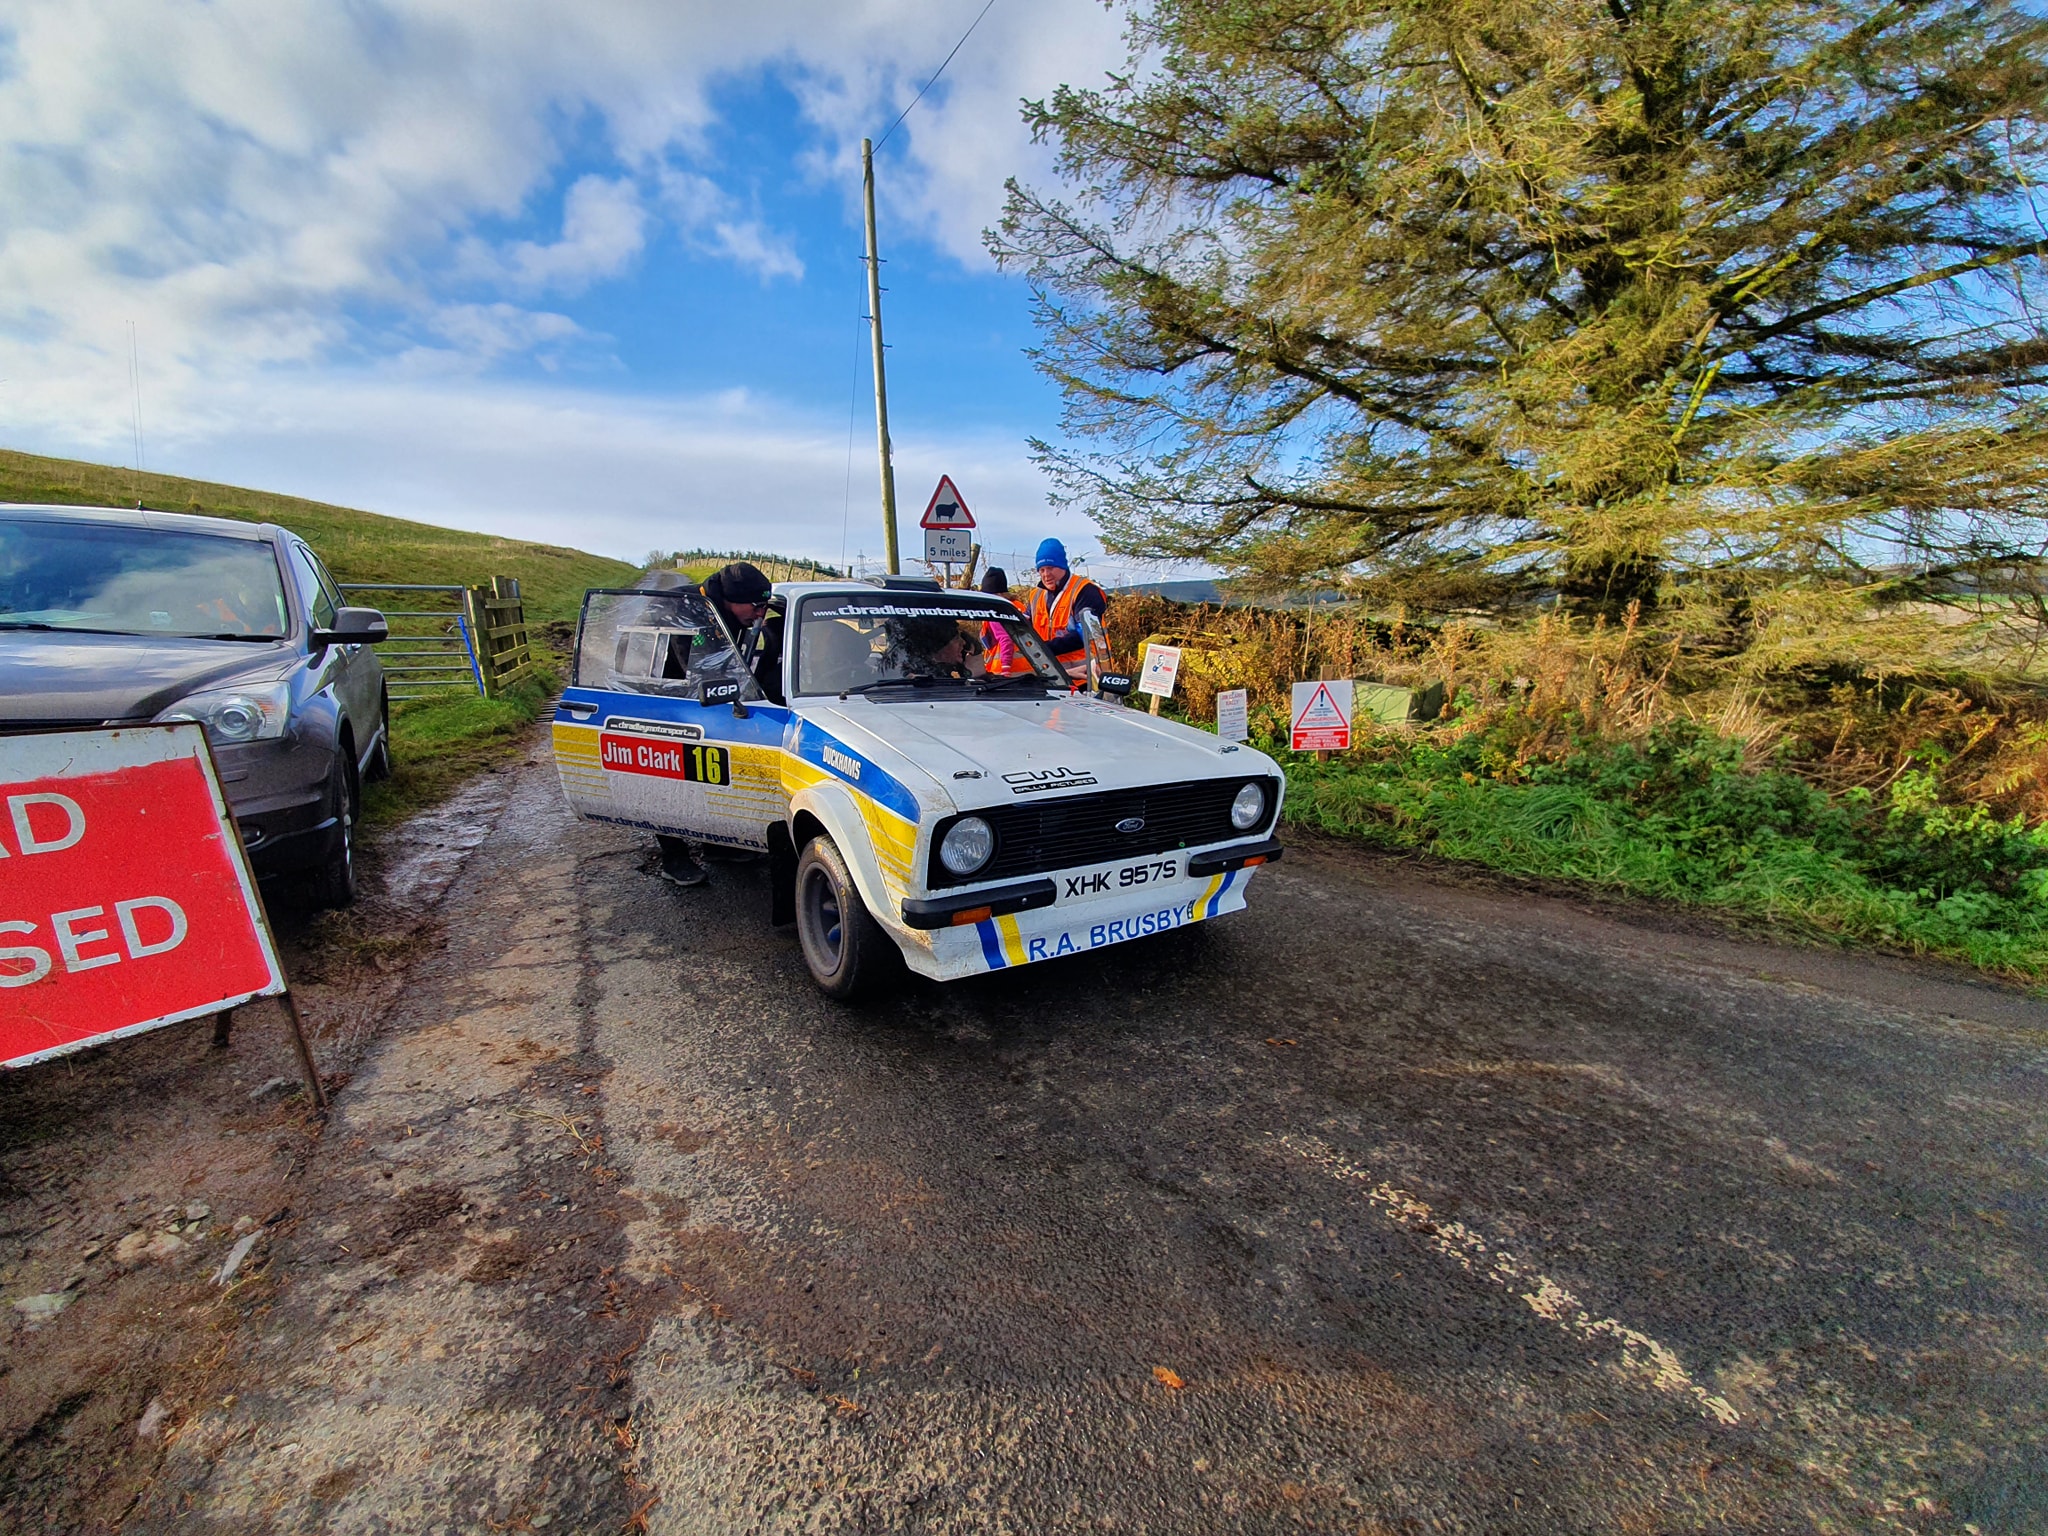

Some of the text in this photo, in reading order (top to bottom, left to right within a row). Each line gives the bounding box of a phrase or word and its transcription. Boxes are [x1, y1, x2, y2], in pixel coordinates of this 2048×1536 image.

[930, 547, 967, 558] 5 miles
[940, 535, 956, 545] For
[812, 605, 1020, 622] www.cbradleymotorsport.co.uk
[706, 684, 738, 698] KGP
[1101, 675, 1130, 686] KGP
[603, 741, 681, 772] Jim Clark
[692, 746, 721, 784] 16
[0, 792, 86, 859] D
[1064, 859, 1177, 899] XHK 957S
[0, 895, 188, 988] SED
[1029, 932, 1082, 962] R.A.
[1090, 904, 1187, 948] BRUSBY
